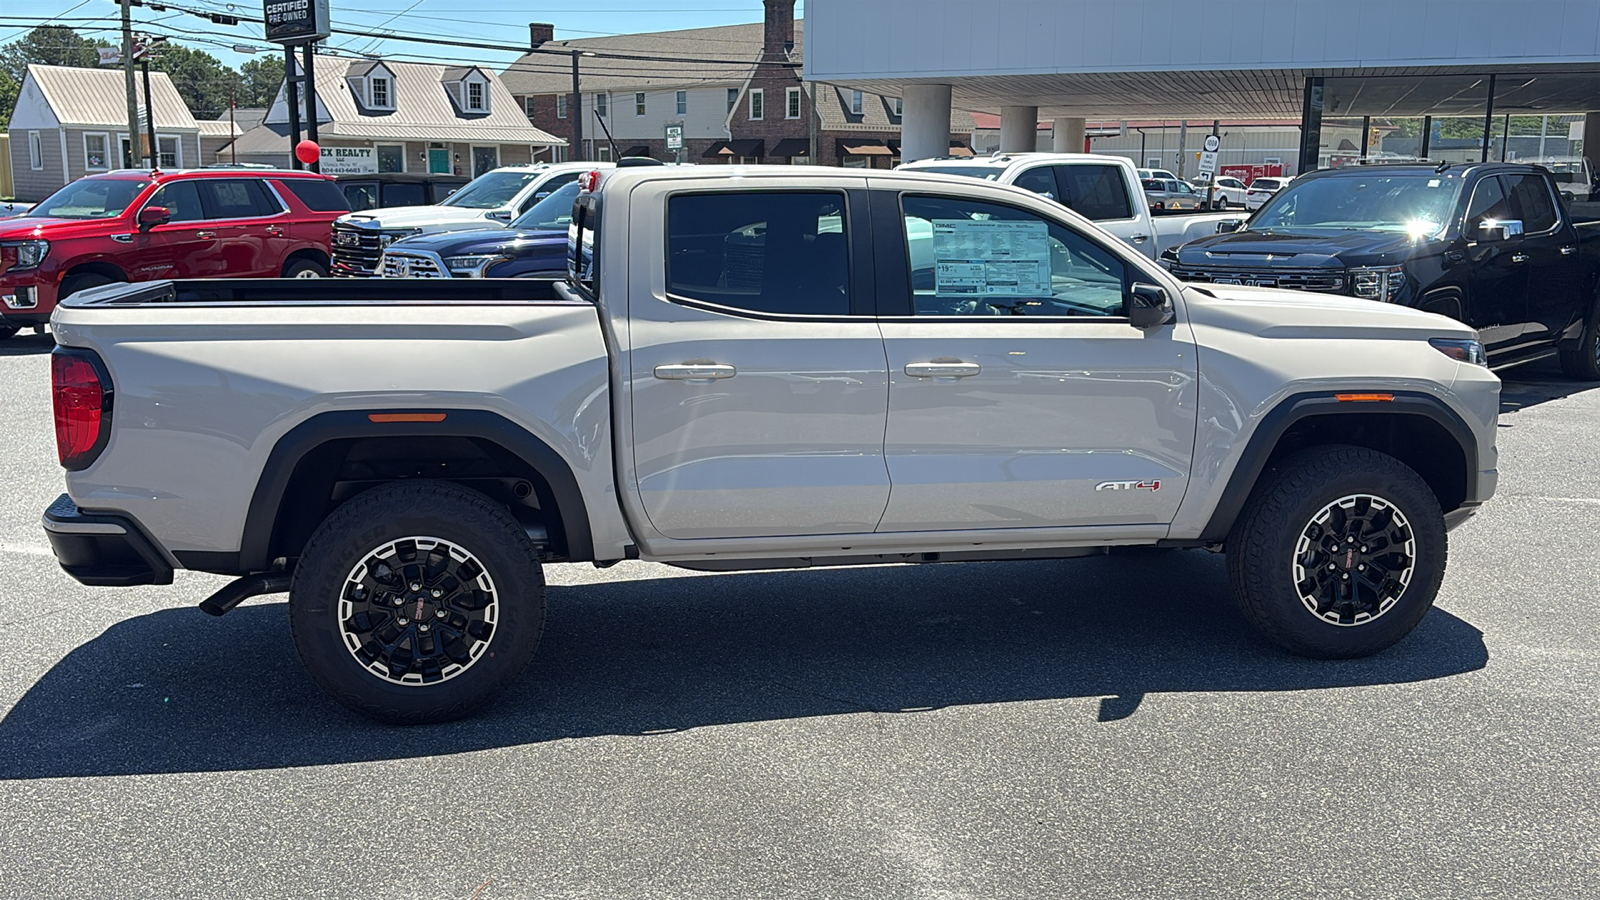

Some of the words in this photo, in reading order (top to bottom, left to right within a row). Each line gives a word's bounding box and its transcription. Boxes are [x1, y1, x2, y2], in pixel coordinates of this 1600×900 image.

[266, 0, 308, 14] CERTIFIED
[268, 10, 308, 23] PRE-OWNED
[335, 148, 371, 158] REALTY
[1095, 479, 1162, 493] AT4
